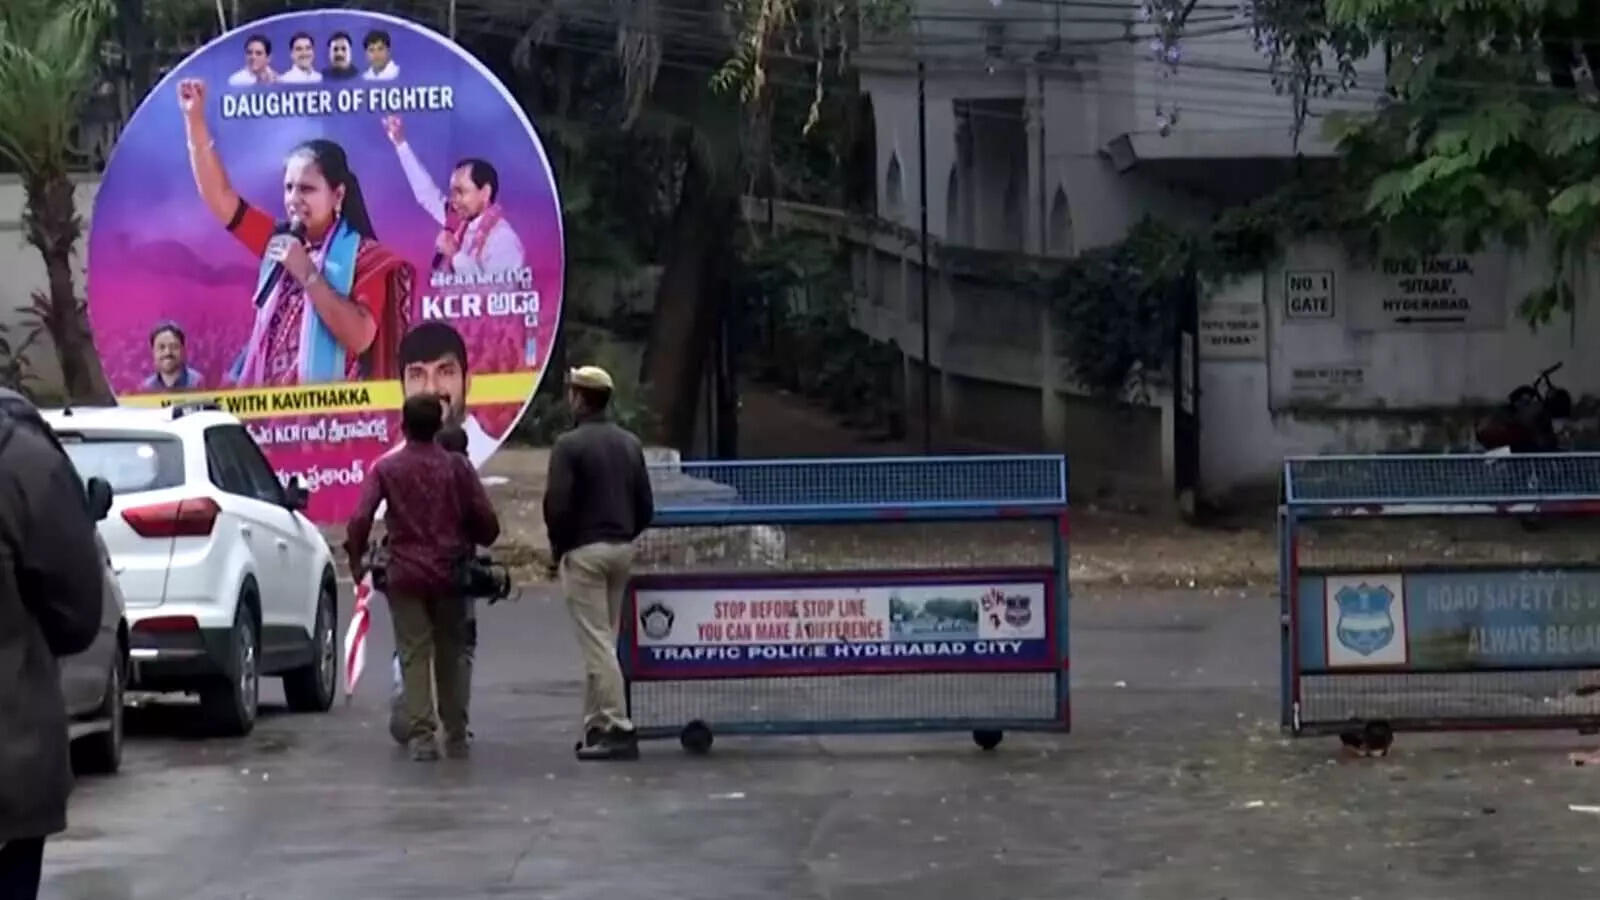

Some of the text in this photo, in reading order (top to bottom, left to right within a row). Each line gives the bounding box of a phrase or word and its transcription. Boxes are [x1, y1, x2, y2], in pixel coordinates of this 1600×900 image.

[223, 86, 454, 118] DAUGHTER OF FIGHTER
[1322, 276, 1327, 290] 1
[422, 293, 482, 320] KCR
[1290, 296, 1327, 312] GATE
[226, 395, 266, 412] WITH
[272, 388, 370, 409] KAVITHAKKA
[1486, 581, 1554, 611] SAFETY
[714, 599, 865, 619] STOP BEFORE STOP LINE
[698, 622, 722, 641] YOU
[726, 621, 752, 640] CAN
[755, 620, 790, 640] MAKE
[1468, 624, 1540, 656] ALWAYS
[652, 639, 1024, 661] TRAFFIC POLICE HYDERABAD CITY
